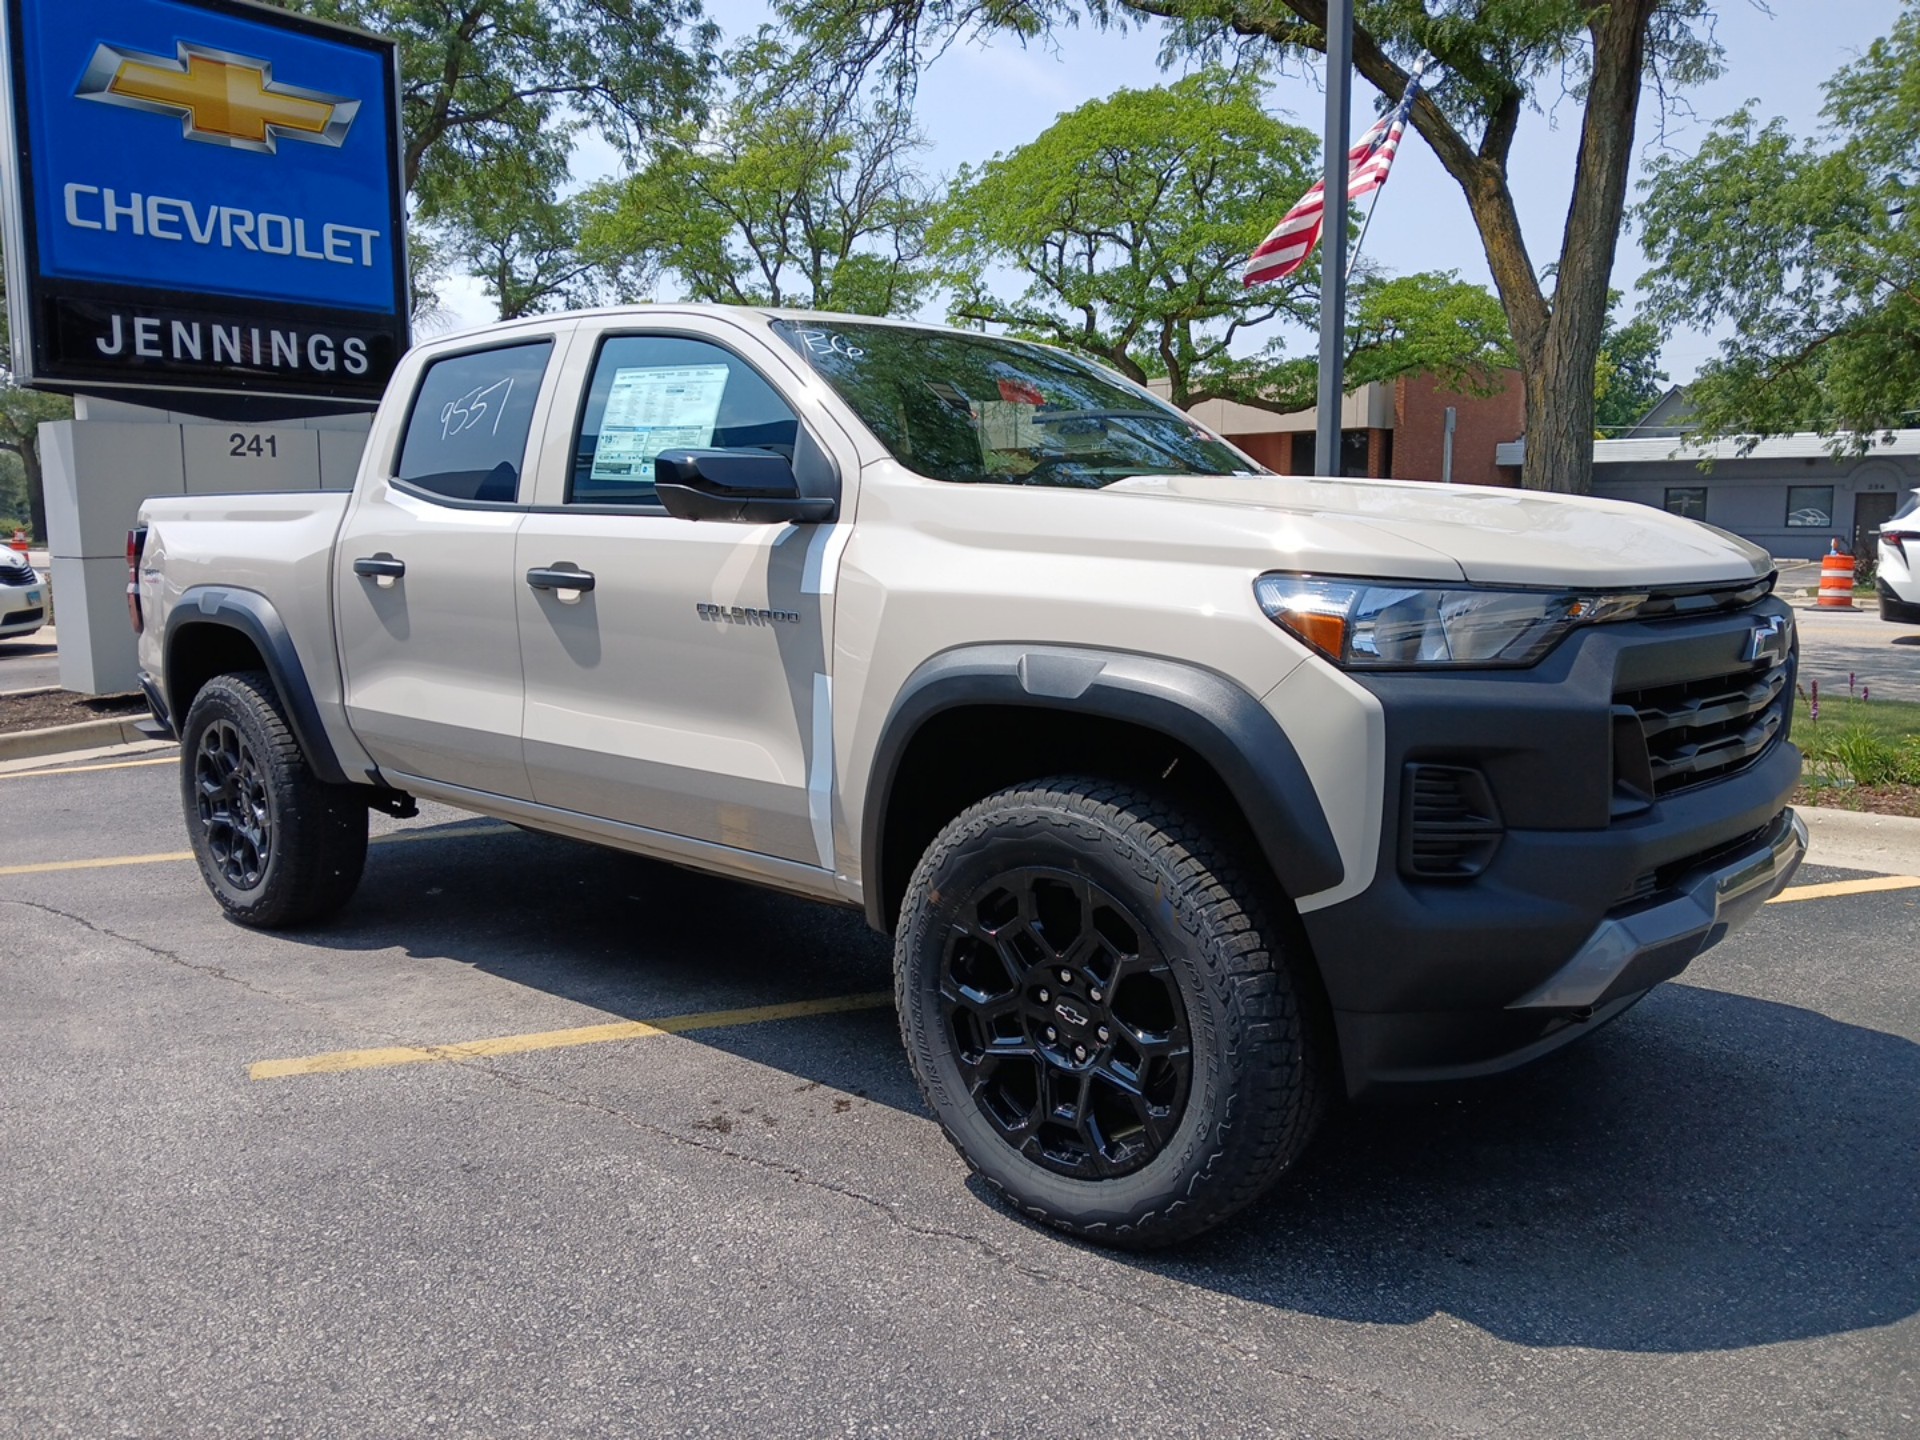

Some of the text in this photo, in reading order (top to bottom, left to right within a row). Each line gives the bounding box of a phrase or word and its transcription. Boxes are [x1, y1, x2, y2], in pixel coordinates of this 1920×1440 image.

[64, 182, 380, 266] CHEVROLET
[96, 314, 369, 374] JENNINGS
[228, 433, 278, 458] 241
[696, 603, 800, 623] COLORADO
